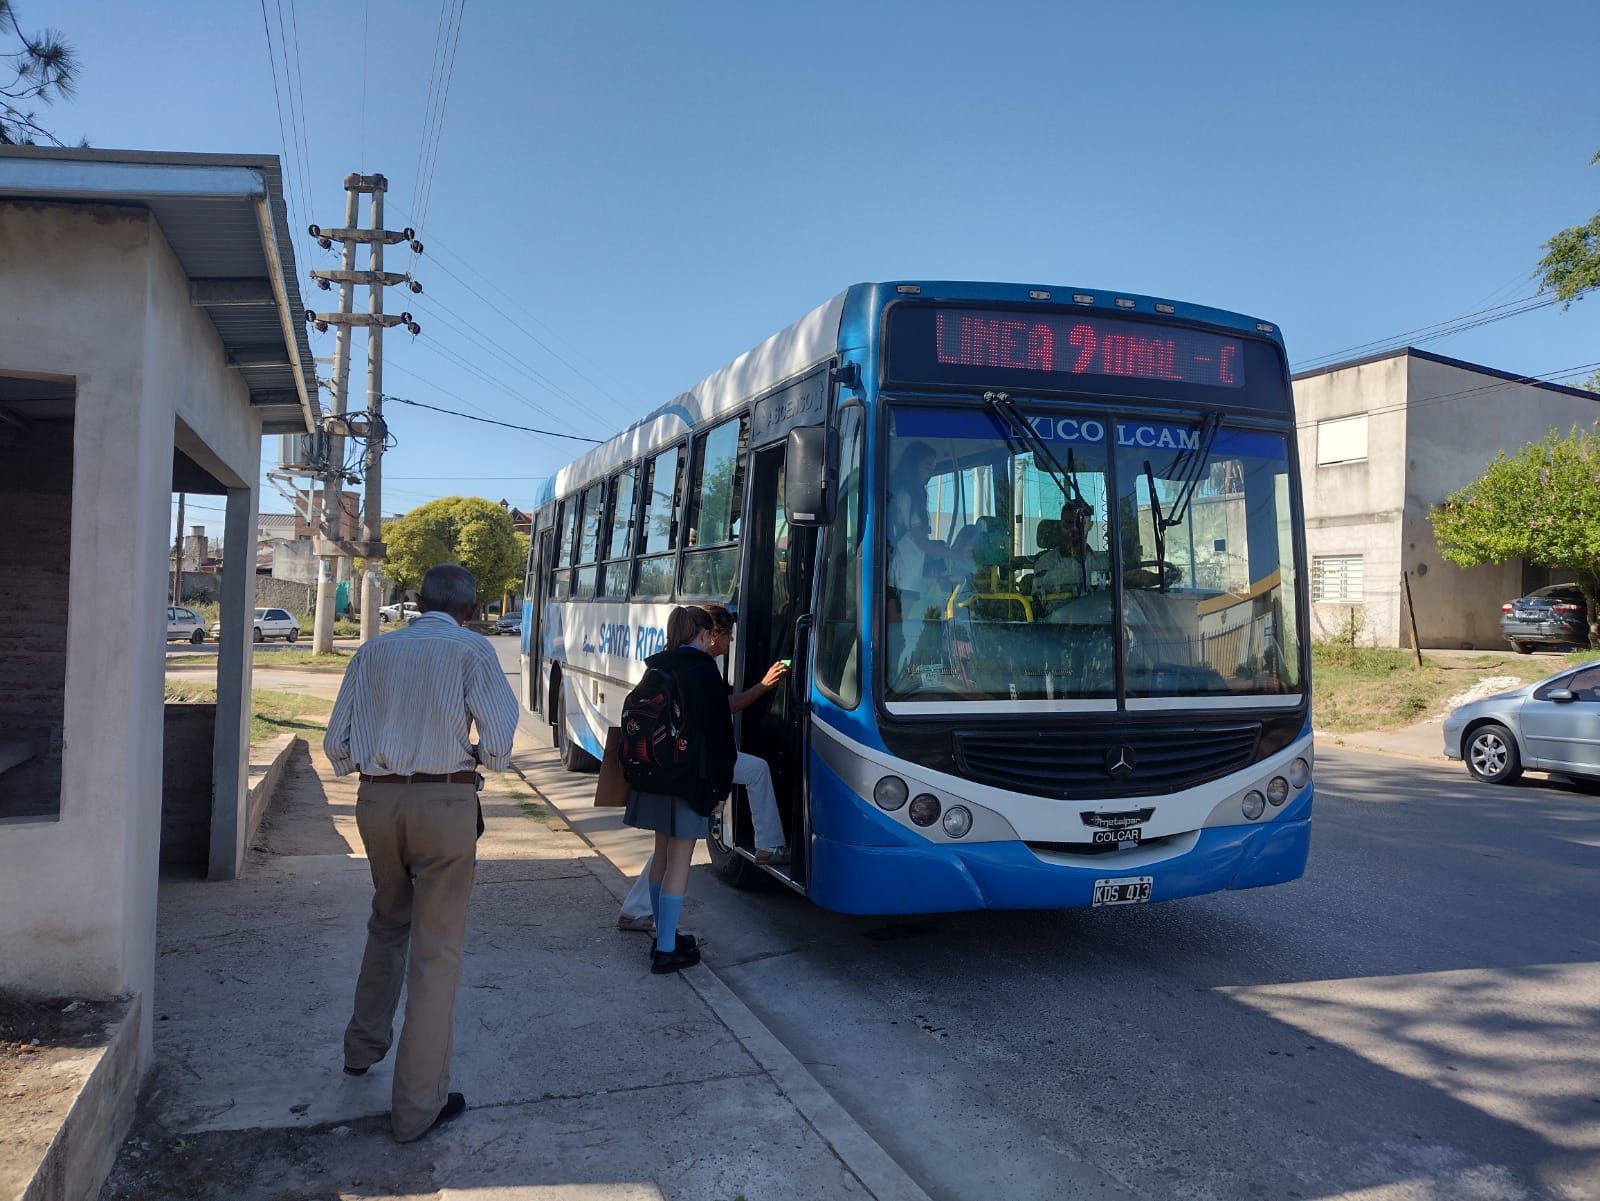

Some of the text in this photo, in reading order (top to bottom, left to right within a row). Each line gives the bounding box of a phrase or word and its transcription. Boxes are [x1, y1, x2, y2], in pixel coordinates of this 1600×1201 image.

[1069, 323, 1097, 375] 9
[599, 623, 631, 658] SANTA
[635, 626, 665, 661] RITA
[1096, 829, 1138, 843] COLCAR
[1095, 883, 1150, 903] KDS 413
